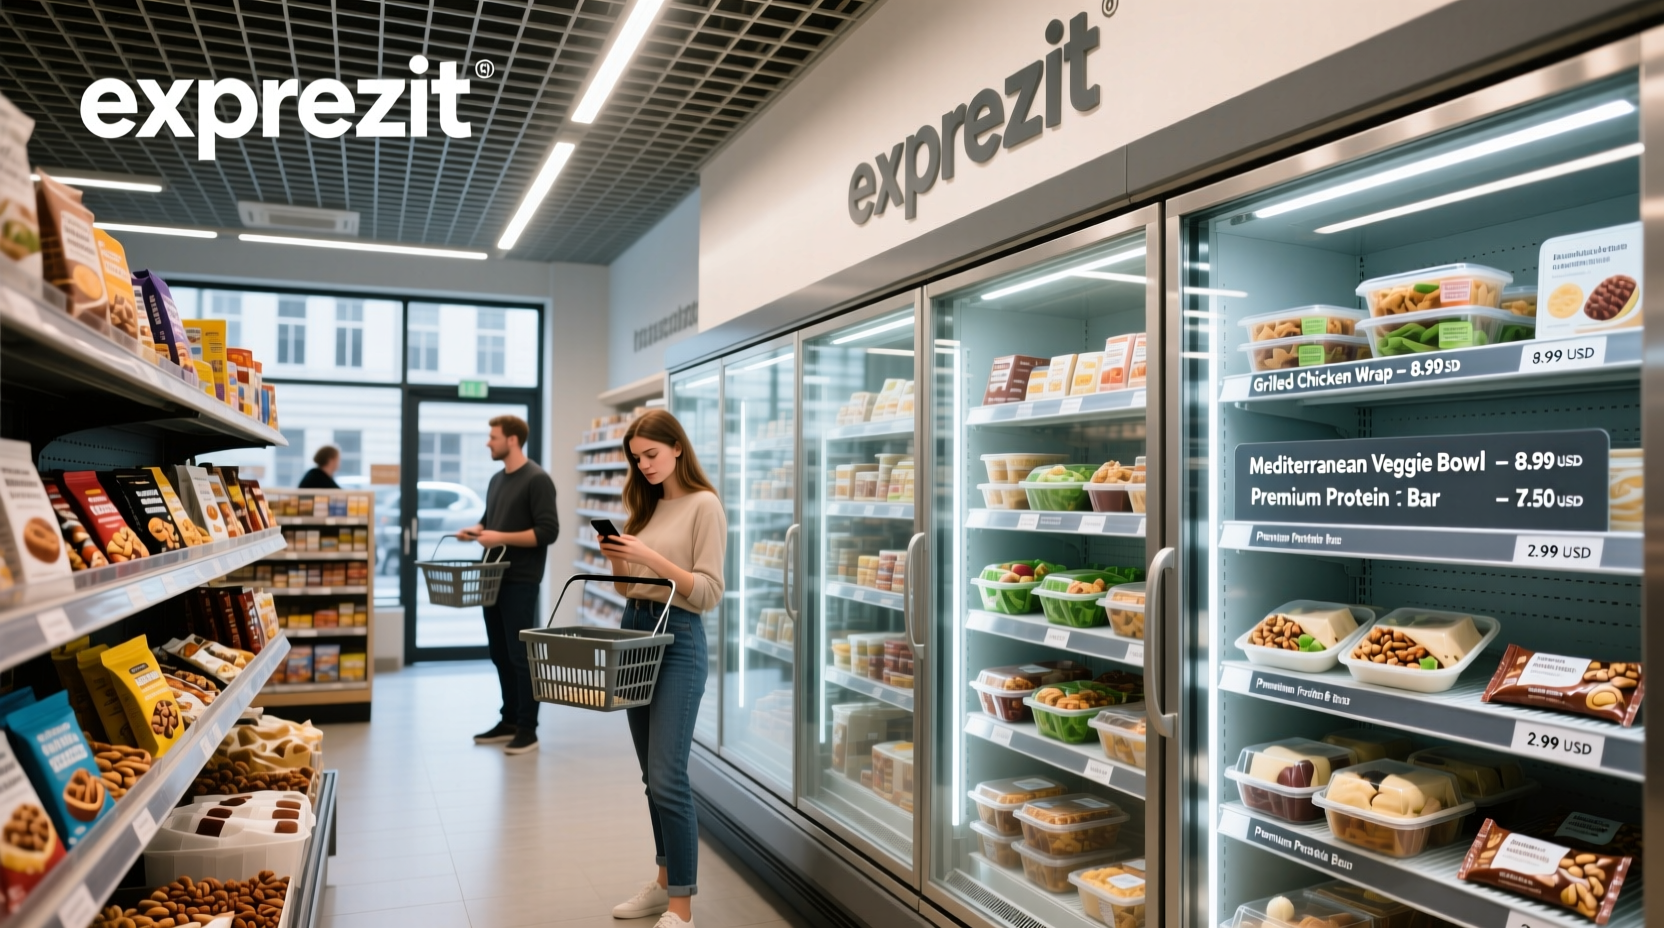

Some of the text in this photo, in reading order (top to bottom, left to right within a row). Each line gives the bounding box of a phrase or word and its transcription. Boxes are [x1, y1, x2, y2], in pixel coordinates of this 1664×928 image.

[1532, 347, 1595, 365] 8.99 USD
[1297, 367, 1352, 388] Chicken
[1354, 365, 1393, 385] Wrap
[1249, 454, 1368, 475] Mediterranean
[1370, 452, 1433, 479] Veggie
[1437, 450, 1486, 472] Bowl
[1514, 451, 1555, 471] 8.99
[1556, 454, 1584, 468] USD
[1251, 486, 1321, 506] Premium
[1326, 486, 1390, 507] Protein
[1407, 487, 1441, 508] Bar
[1515, 488, 1555, 508] 7.50
[1556, 495, 1584, 508] USD
[1527, 544, 1592, 559] 2.99 USD
[1527, 731, 1592, 755] 2.99 USD
